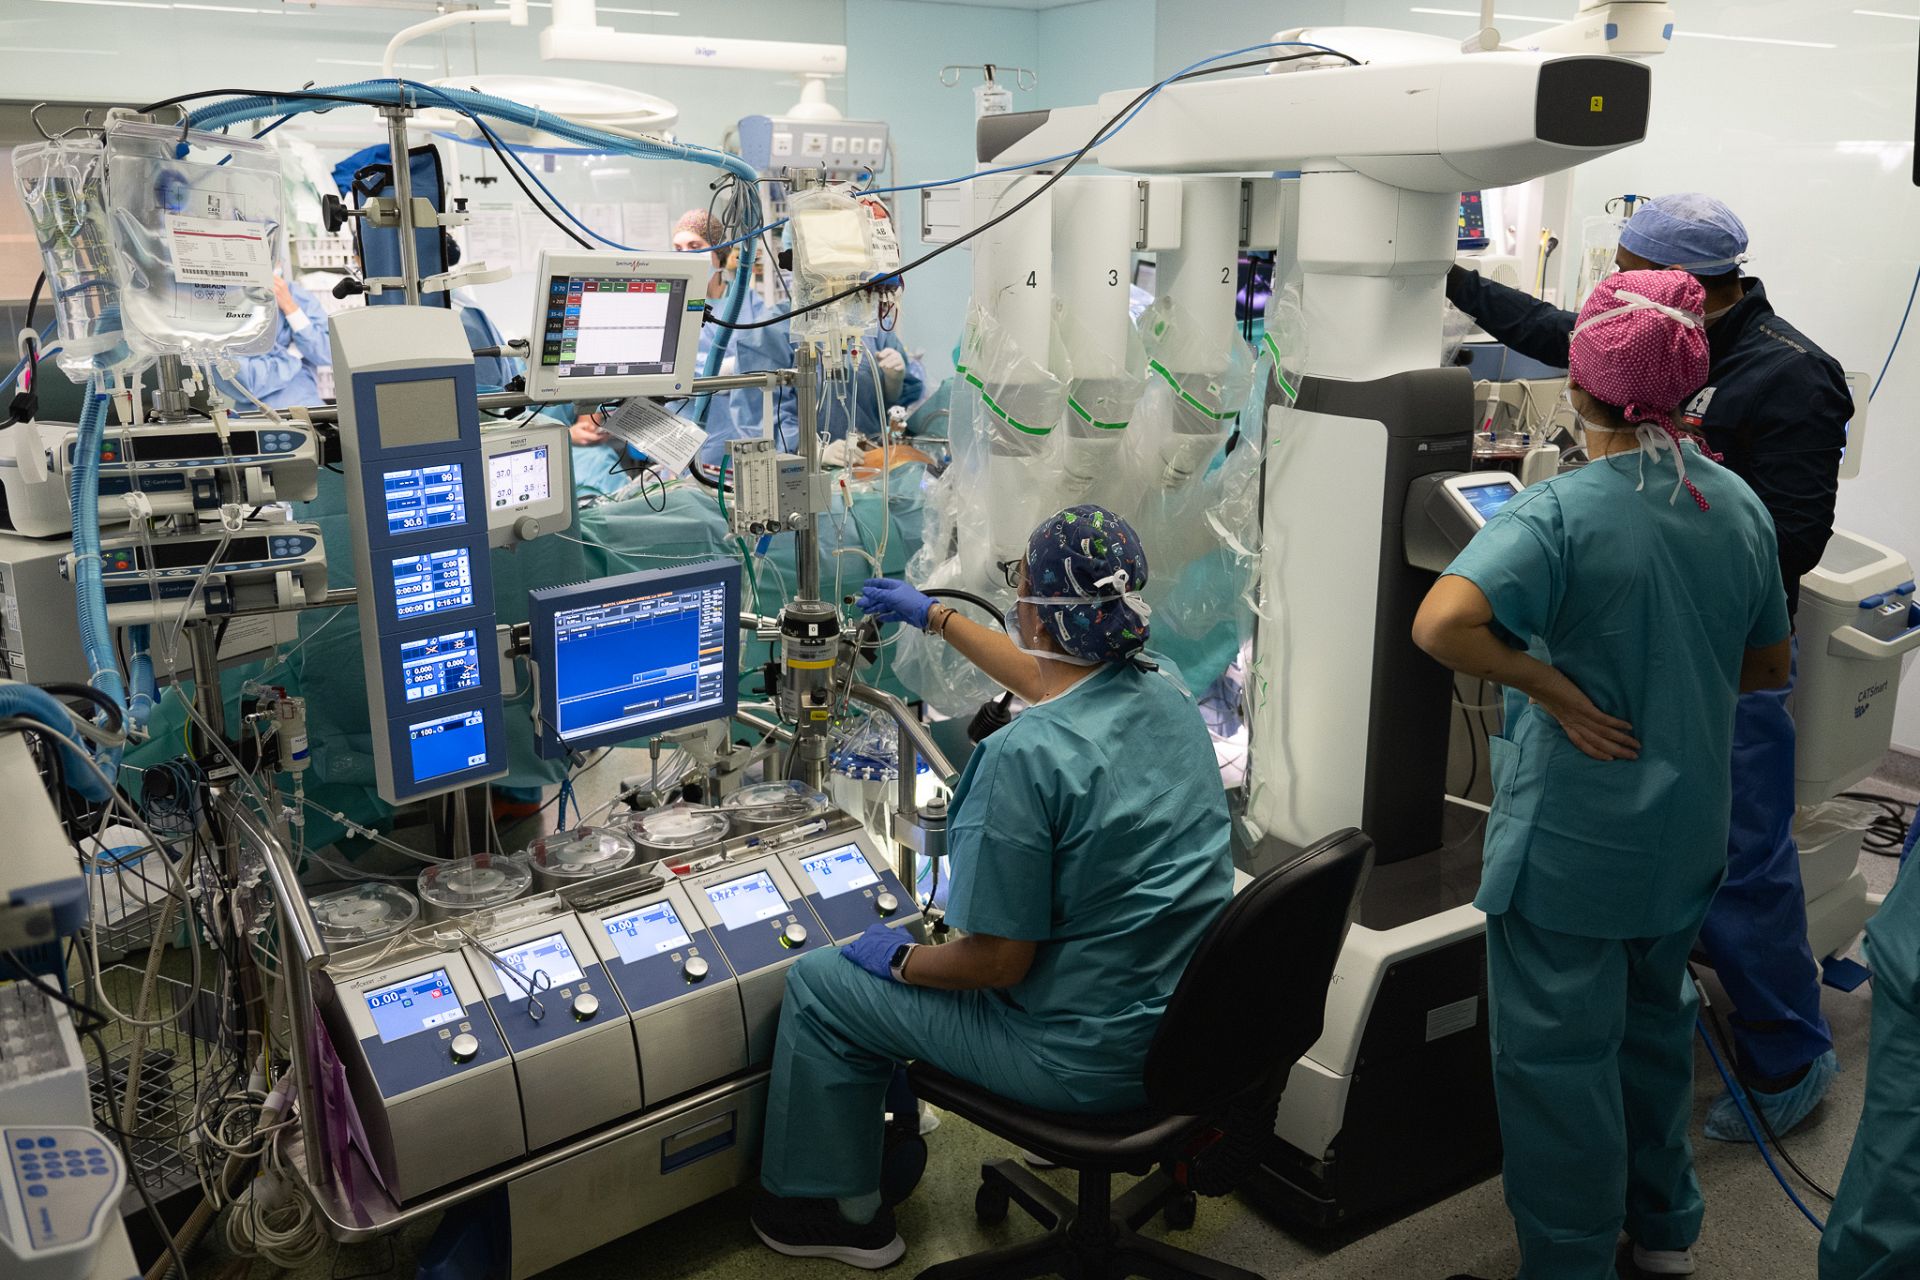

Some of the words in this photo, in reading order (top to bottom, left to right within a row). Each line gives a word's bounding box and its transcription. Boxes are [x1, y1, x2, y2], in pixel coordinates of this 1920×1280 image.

[1026, 270, 1037, 289] 4
[1108, 269, 1118, 287] 3
[1221, 267, 1230, 285] 2
[496, 469, 511, 478] 37.0
[497, 488, 512, 497] 37.0
[450, 512, 457, 521] 2
[416, 563, 423, 571] 0
[442, 560, 457, 568] 0:00
[443, 570, 458, 578] 0:00
[444, 580, 459, 588] 0:00
[396, 585, 421, 595] 0:00:00
[398, 604, 424, 614] 0:00:00
[446, 659, 464, 667] 0.000
[414, 666, 432, 674] 0.000
[414, 674, 433, 682] 00:00
[1858, 680, 1888, 703] CATSmart
[420, 728, 433, 736] 100
[806, 860, 827, 872] 0.00
[609, 920, 633, 933] 0.00
[436, 980, 443, 988] 0
[371, 991, 399, 1008] 0.00
